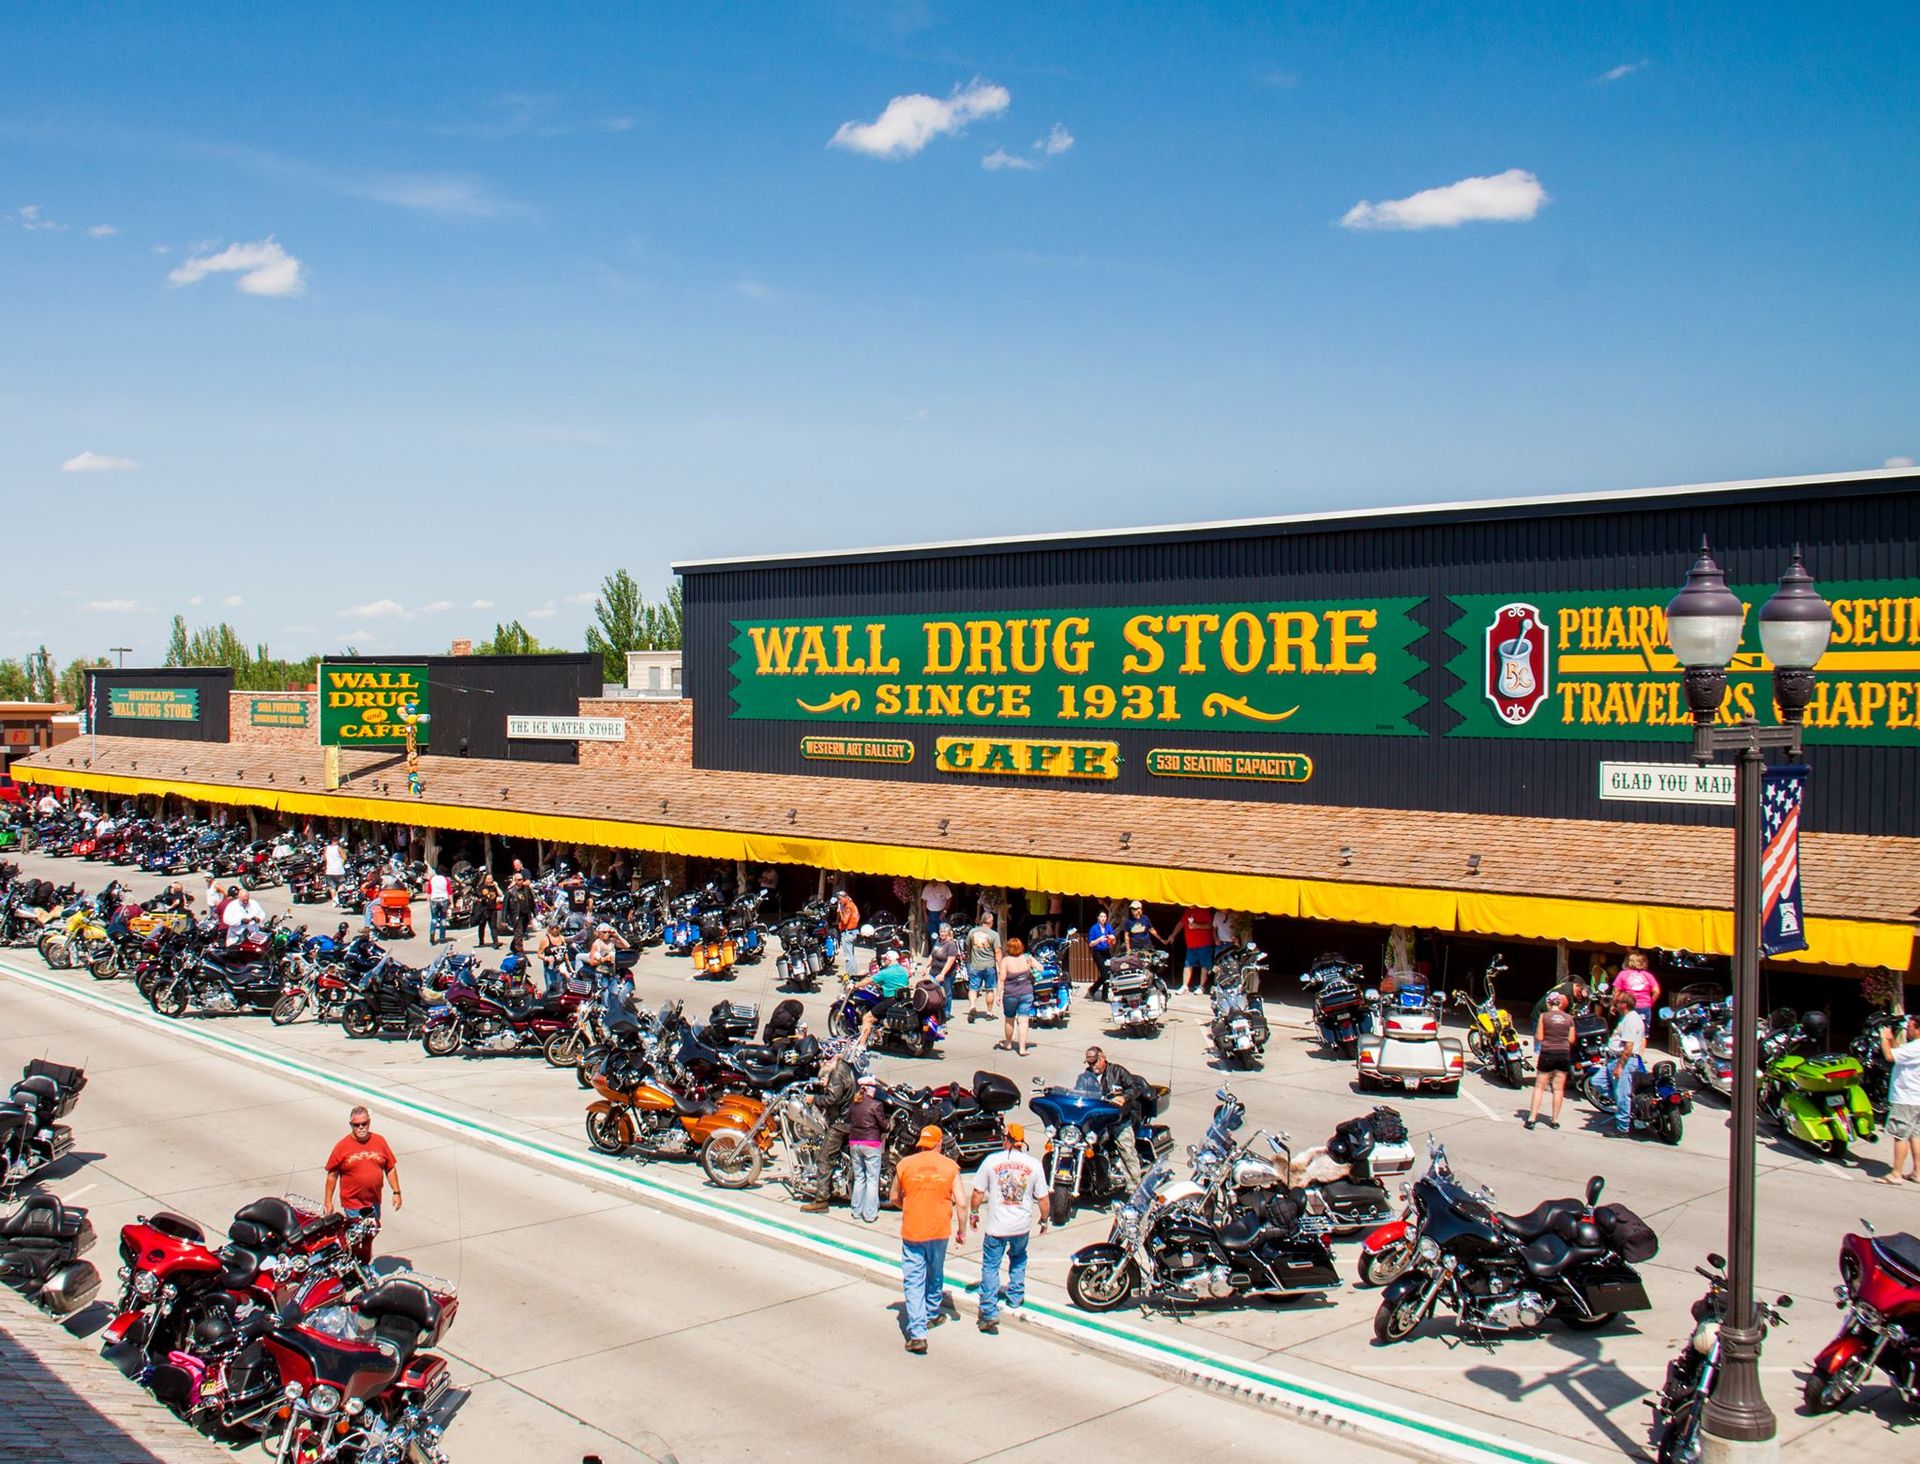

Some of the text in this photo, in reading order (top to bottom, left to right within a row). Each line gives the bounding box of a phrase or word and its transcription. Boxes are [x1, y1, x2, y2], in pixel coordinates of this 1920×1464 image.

[1557, 602, 1752, 651] PHARM
[748, 609, 1378, 676] WALL DRUG STORE
[328, 672, 419, 689] WALL
[328, 691, 420, 708] DRUG
[875, 683, 1182, 722] SINCE 1931
[1556, 681, 1920, 730] TRAVELRS HAPE
[112, 702, 193, 719] WALL DRUG STORE
[339, 724, 409, 738] CAFE
[510, 721, 621, 736] THE ICE WATER STORE
[806, 741, 905, 758] WESTERN ART GALLERY
[944, 742, 1107, 776] CAFE
[1156, 755, 1297, 776] 530 SEATING CAPACITY
[1611, 772, 1736, 794] GLAD YOU MAD
